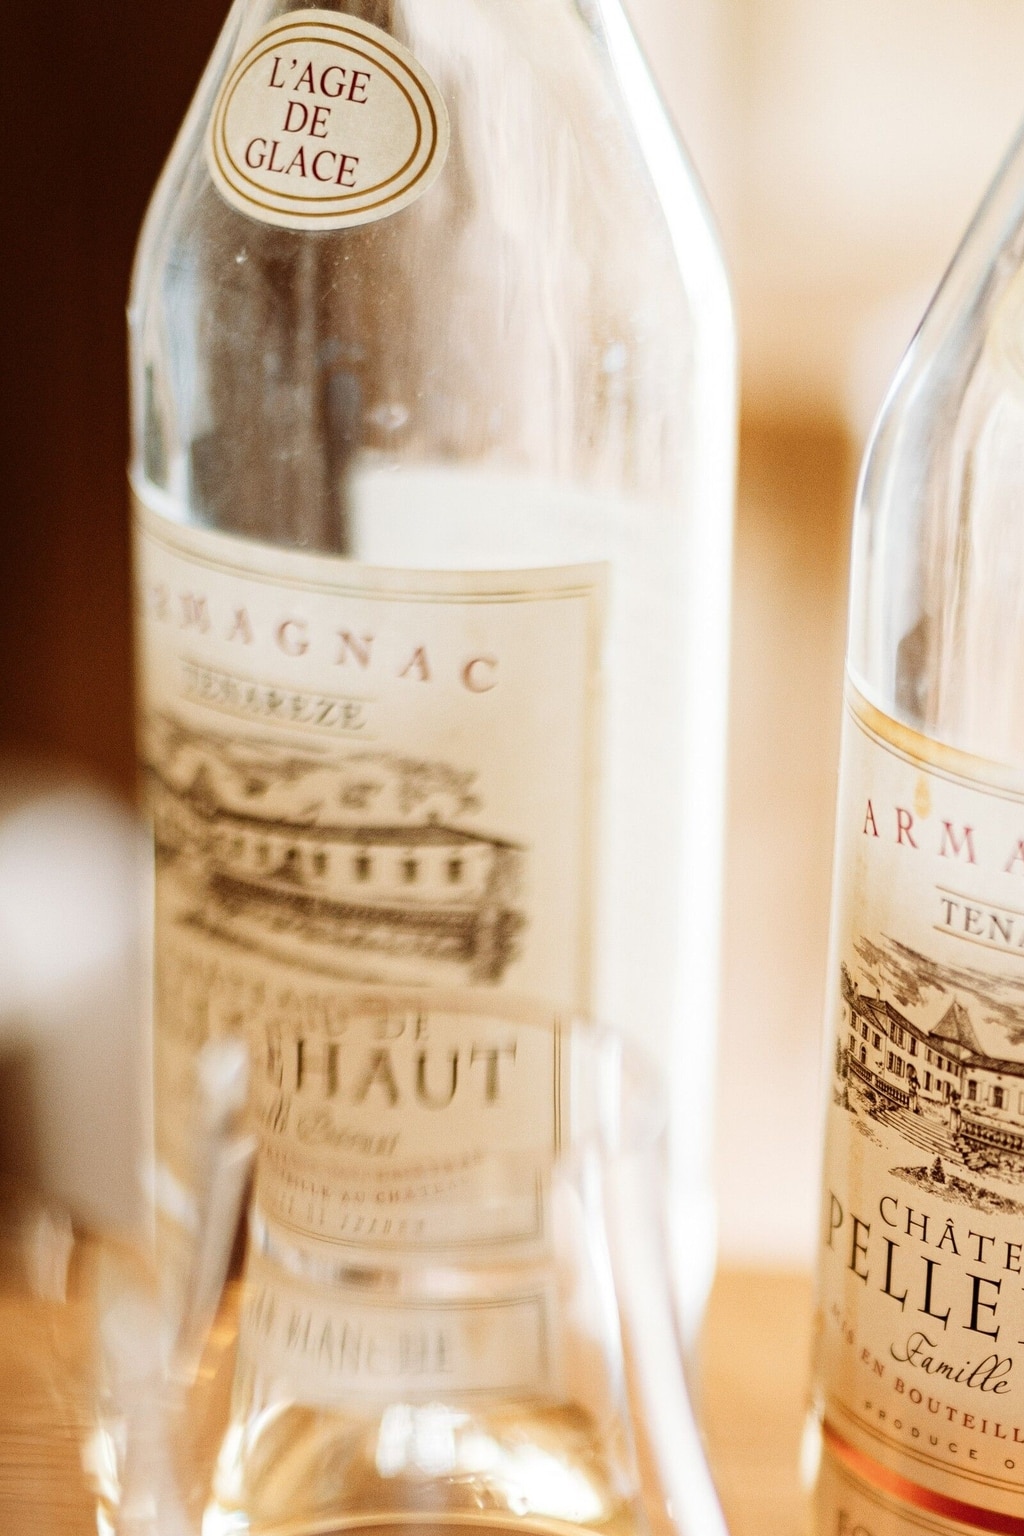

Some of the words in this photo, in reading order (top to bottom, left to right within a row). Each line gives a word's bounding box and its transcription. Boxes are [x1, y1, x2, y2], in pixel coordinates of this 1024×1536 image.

[267, 56, 372, 105] L'AGE
[282, 100, 332, 139] DE
[244, 137, 360, 188] GLACE
[265, 1018, 519, 1111] HAUT
[859, 1347, 886, 1379] EN
[890, 1331, 1013, 1395] Famille
[863, 1400, 979, 1460] PRODUCE
